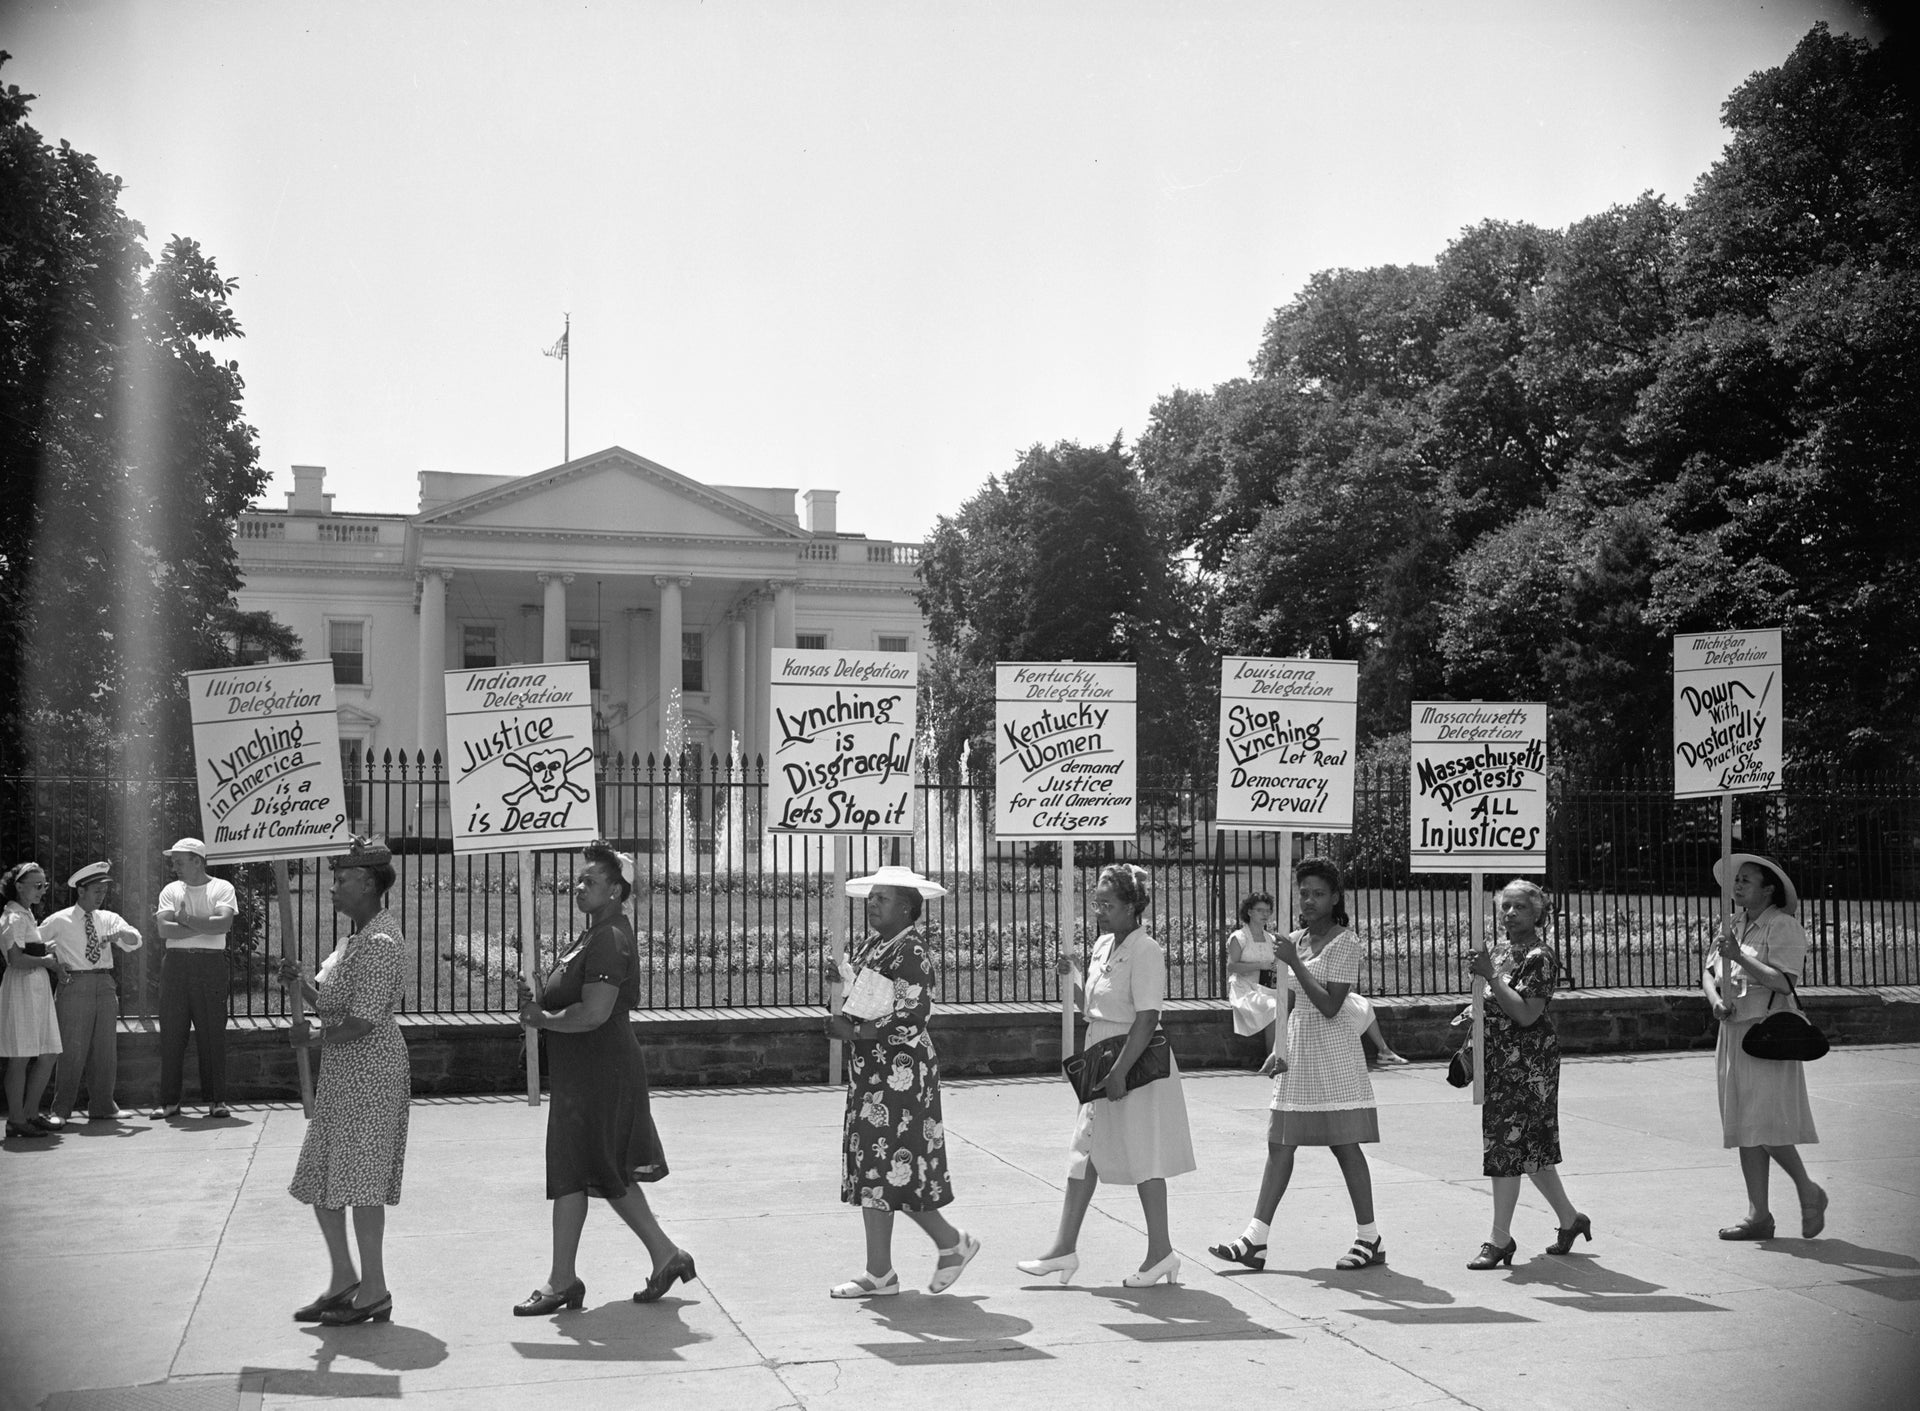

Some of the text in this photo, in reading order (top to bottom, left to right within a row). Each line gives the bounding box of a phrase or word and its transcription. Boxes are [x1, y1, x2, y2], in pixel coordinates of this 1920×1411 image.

[1692, 635, 1746, 651] Michigan
[1704, 645, 1768, 665] Delegation
[466, 671, 546, 691] Indiana
[782, 658, 909, 681] Kansas Delegation
[1014, 668, 1096, 688] Kentucky
[1234, 662, 1316, 680] Louisiana
[205, 676, 272, 697] Illinois
[483, 685, 573, 709] Delegation
[1026, 681, 1114, 700] Delegation
[1251, 679, 1334, 697] Delegation
[228, 689, 322, 715] Delegation
[1708, 700, 1739, 724] With
[776, 690, 901, 747] Lynching
[1003, 702, 1109, 749] Kentucky
[1228, 705, 1280, 737] Stop
[1420, 707, 1528, 724] Massachusetts
[836, 731, 855, 752] is
[1226, 717, 1324, 766] Lynching
[1437, 724, 1524, 741] Delegation
[1677, 709, 1766, 768] Dastardly
[208, 720, 303, 787] Lynching
[461, 716, 554, 773] Justice
[1018, 733, 1102, 772] Women
[1279, 745, 1347, 767] Let Real
[1703, 737, 1762, 772] Practices
[782, 732, 914, 795] Disgraceful
[1061, 759, 1124, 775] demand
[1417, 738, 1545, 795] Massachusetts
[1733, 752, 1763, 773] Stop
[207, 751, 304, 819] in America
[276, 778, 312, 795] is a
[1038, 775, 1113, 792] Justice
[1230, 767, 1328, 798] Democracy
[1431, 765, 1525, 812] Protests
[1718, 767, 1775, 789] Lynching
[251, 795, 330, 816] Disgrace
[778, 790, 908, 833] Lets Stop it
[1009, 792, 1132, 813] for all American
[1251, 790, 1328, 813] Prevail
[1470, 795, 1519, 820] ALL
[214, 813, 345, 843] Must it Continue?
[468, 801, 573, 833] is Dead
[1032, 811, 1109, 831] Citizens
[1420, 816, 1540, 853] Injustices
